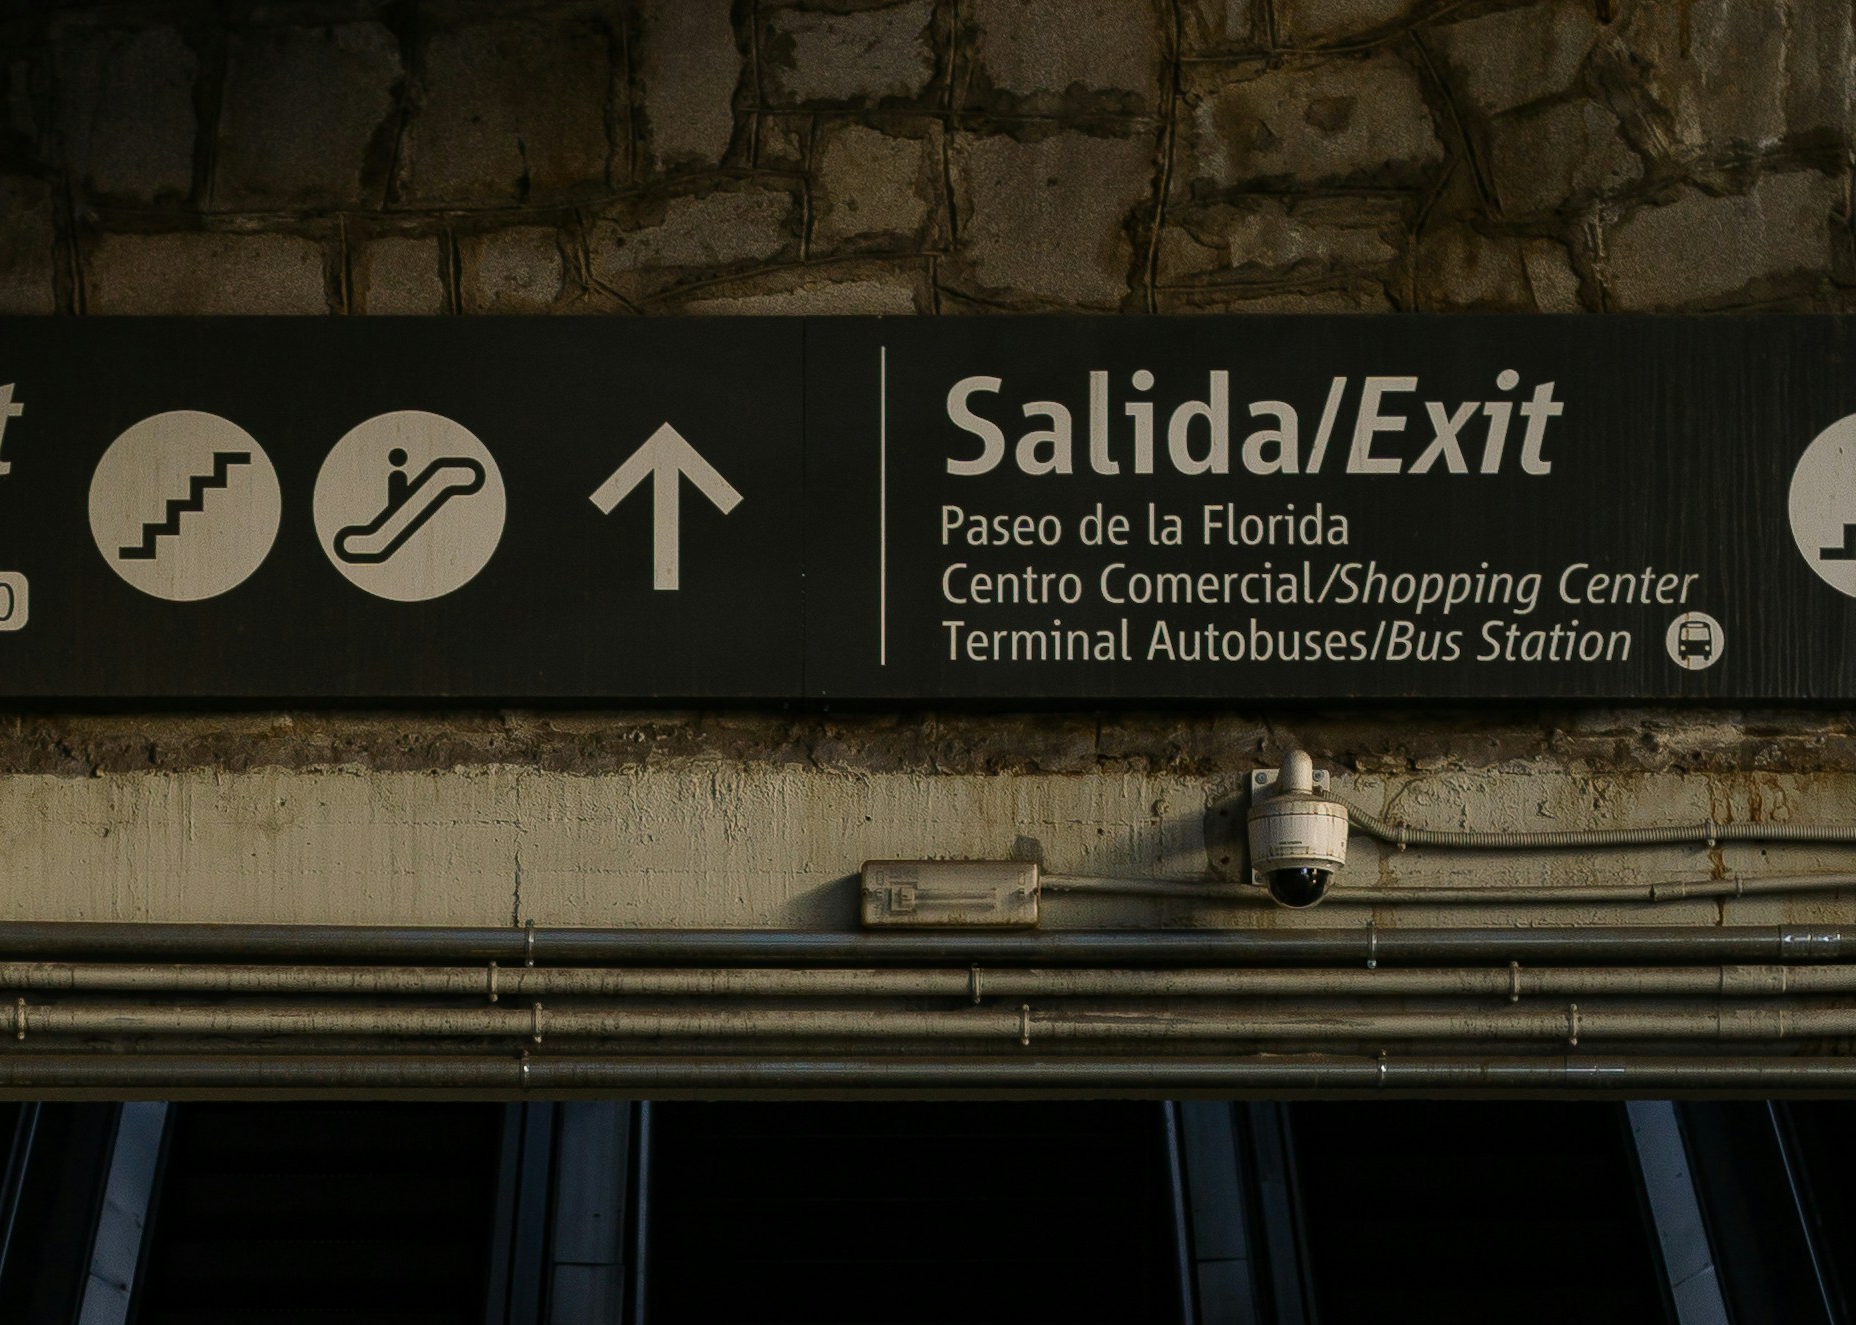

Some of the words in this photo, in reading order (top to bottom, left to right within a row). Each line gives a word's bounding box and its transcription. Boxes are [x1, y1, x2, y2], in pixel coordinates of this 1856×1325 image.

[945, 369, 1565, 476] Salida/Exit
[942, 504, 1063, 546] Paseo
[1079, 503, 1131, 546] de
[1148, 503, 1185, 546] la
[1203, 503, 1350, 547] Florida
[942, 562, 1084, 605] Centro
[1100, 561, 1543, 616] Comercial/Shopping
[1559, 563, 1700, 605] Center
[942, 620, 1133, 662] Terminal
[1146, 619, 1463, 663] Autobuses/Bus
[1477, 620, 1634, 662] Station
